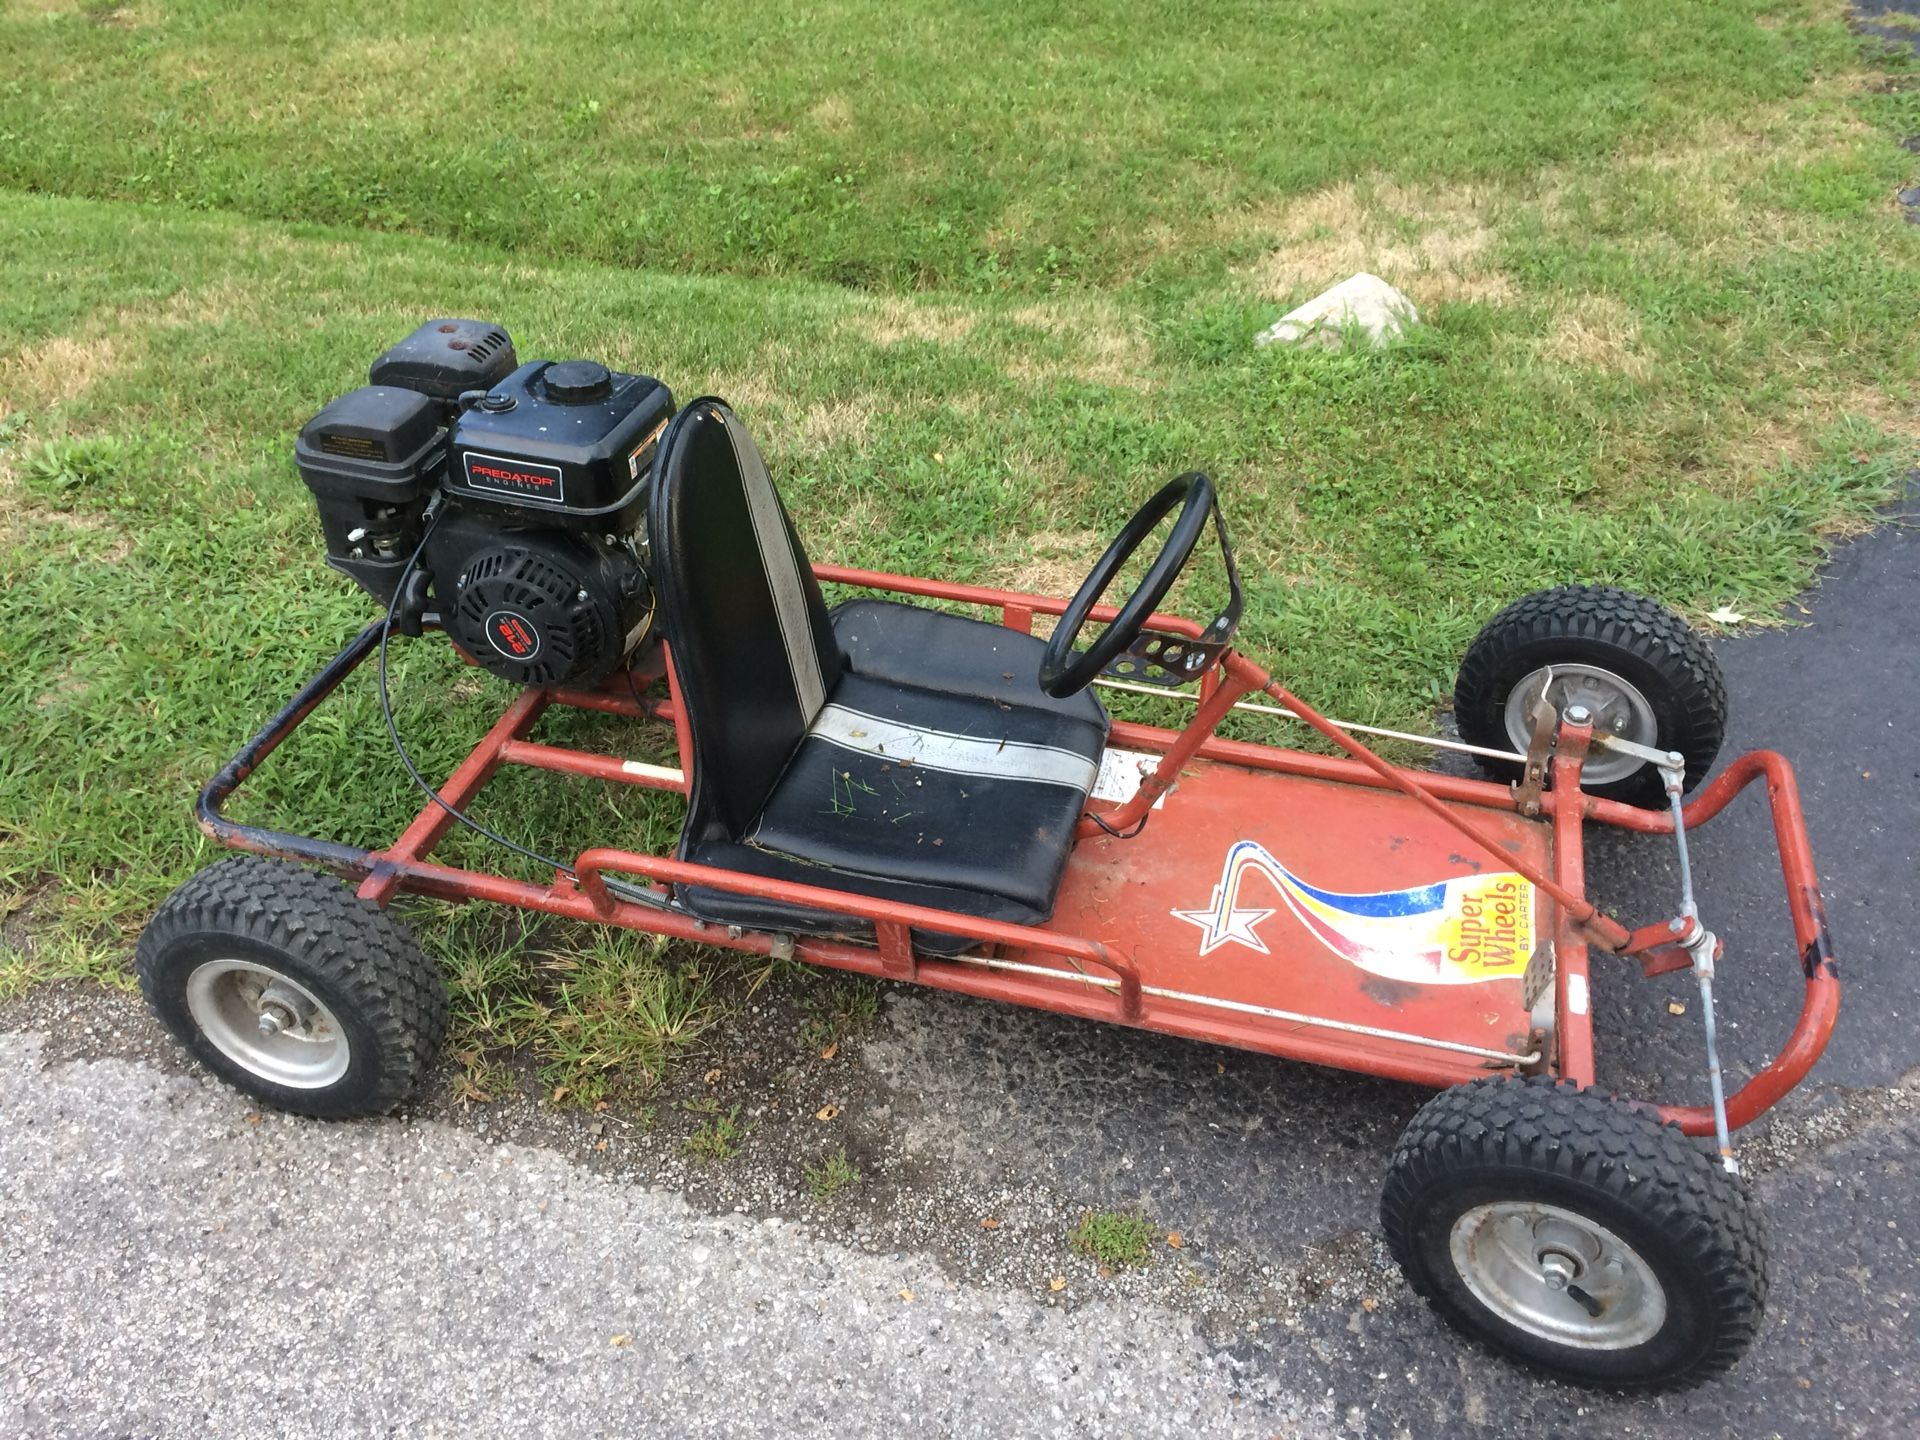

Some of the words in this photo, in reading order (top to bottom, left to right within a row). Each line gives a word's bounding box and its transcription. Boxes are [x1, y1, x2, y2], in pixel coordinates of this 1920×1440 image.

[471, 465, 555, 486] PREDATOR
[486, 476, 540, 491] ENGINES
[1519, 884, 1529, 929] CARTER
[1448, 894, 1490, 964] Super
[1483, 882, 1517, 968] Wheels
[1519, 935, 1529, 951] BY
